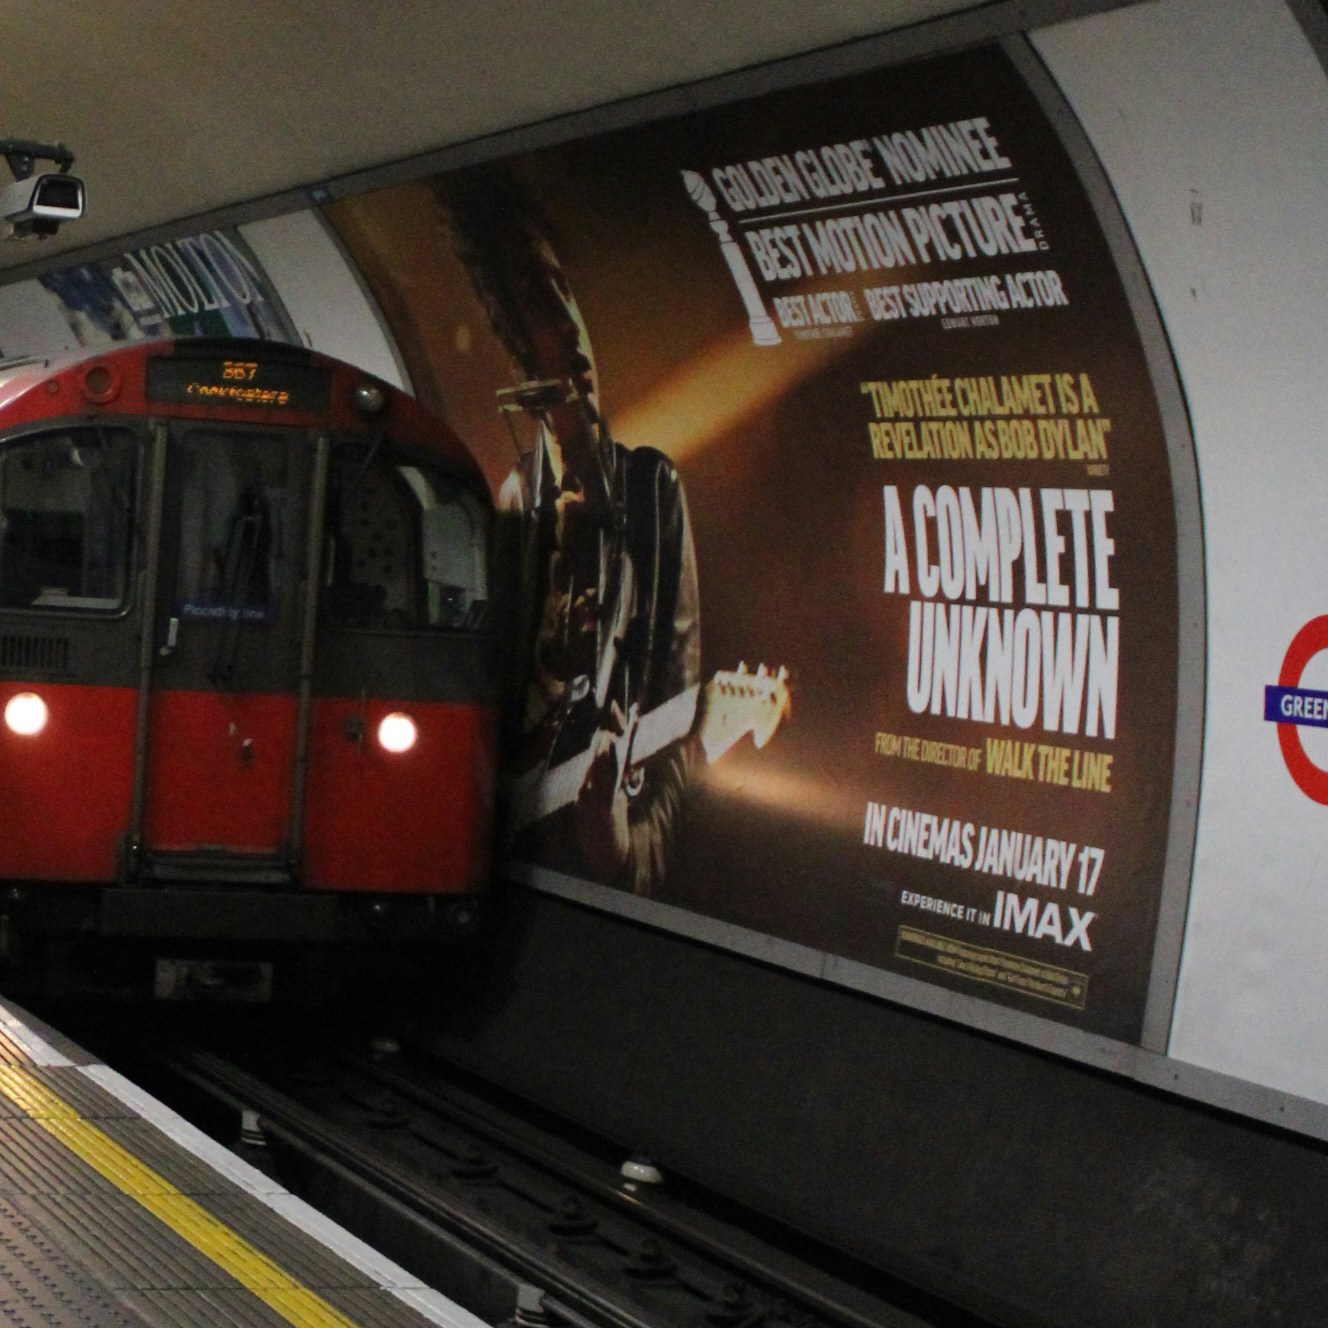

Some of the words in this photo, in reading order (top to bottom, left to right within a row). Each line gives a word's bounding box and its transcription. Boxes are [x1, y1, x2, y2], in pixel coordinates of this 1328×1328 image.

[712, 153, 810, 212] GOLDEN
[794, 139, 885, 199] GLOBE
[873, 116, 1012, 185] NOMINEE
[745, 224, 813, 282] BEST
[802, 210, 914, 275] MOTION
[901, 192, 1039, 264] PICTURE
[1018, 191, 1051, 251] DRAMA
[773, 295, 811, 328] BEST
[807, 291, 859, 324] ACTOR
[864, 286, 907, 321] BEST
[902, 275, 1010, 317] SUPPORTING
[1004, 270, 1069, 309] ACTOR
[954, 374, 1056, 416] CHALAMET
[1055, 373, 1080, 414] IS
[1080, 373, 1100, 414] A
[869, 420, 974, 459] REVELATION
[974, 420, 1000, 459] AS
[997, 419, 1039, 459] BOB
[883, 484, 910, 595] A
[912, 484, 1120, 610] COMPLETE
[906, 600, 1120, 740] UNKNOWN
[875, 731, 901, 757] FROM
[903, 736, 921, 762] THE
[921, 739, 967, 770] DIRECTOR
[966, 748, 982, 771] OF
[986, 737, 1036, 780] WALK
[1038, 743, 1073, 787] THE
[1072, 749, 1114, 793] LINE
[863, 801, 887, 848] IN
[886, 807, 976, 869] CINEMAS
[974, 825, 1077, 890] JANUARY
[1077, 845, 1105, 896] 17
[900, 889, 965, 920] EXPERIENCE
[965, 907, 977, 922] IT
[978, 911, 992, 926] IN
[992, 889, 1096, 952] IMAX
